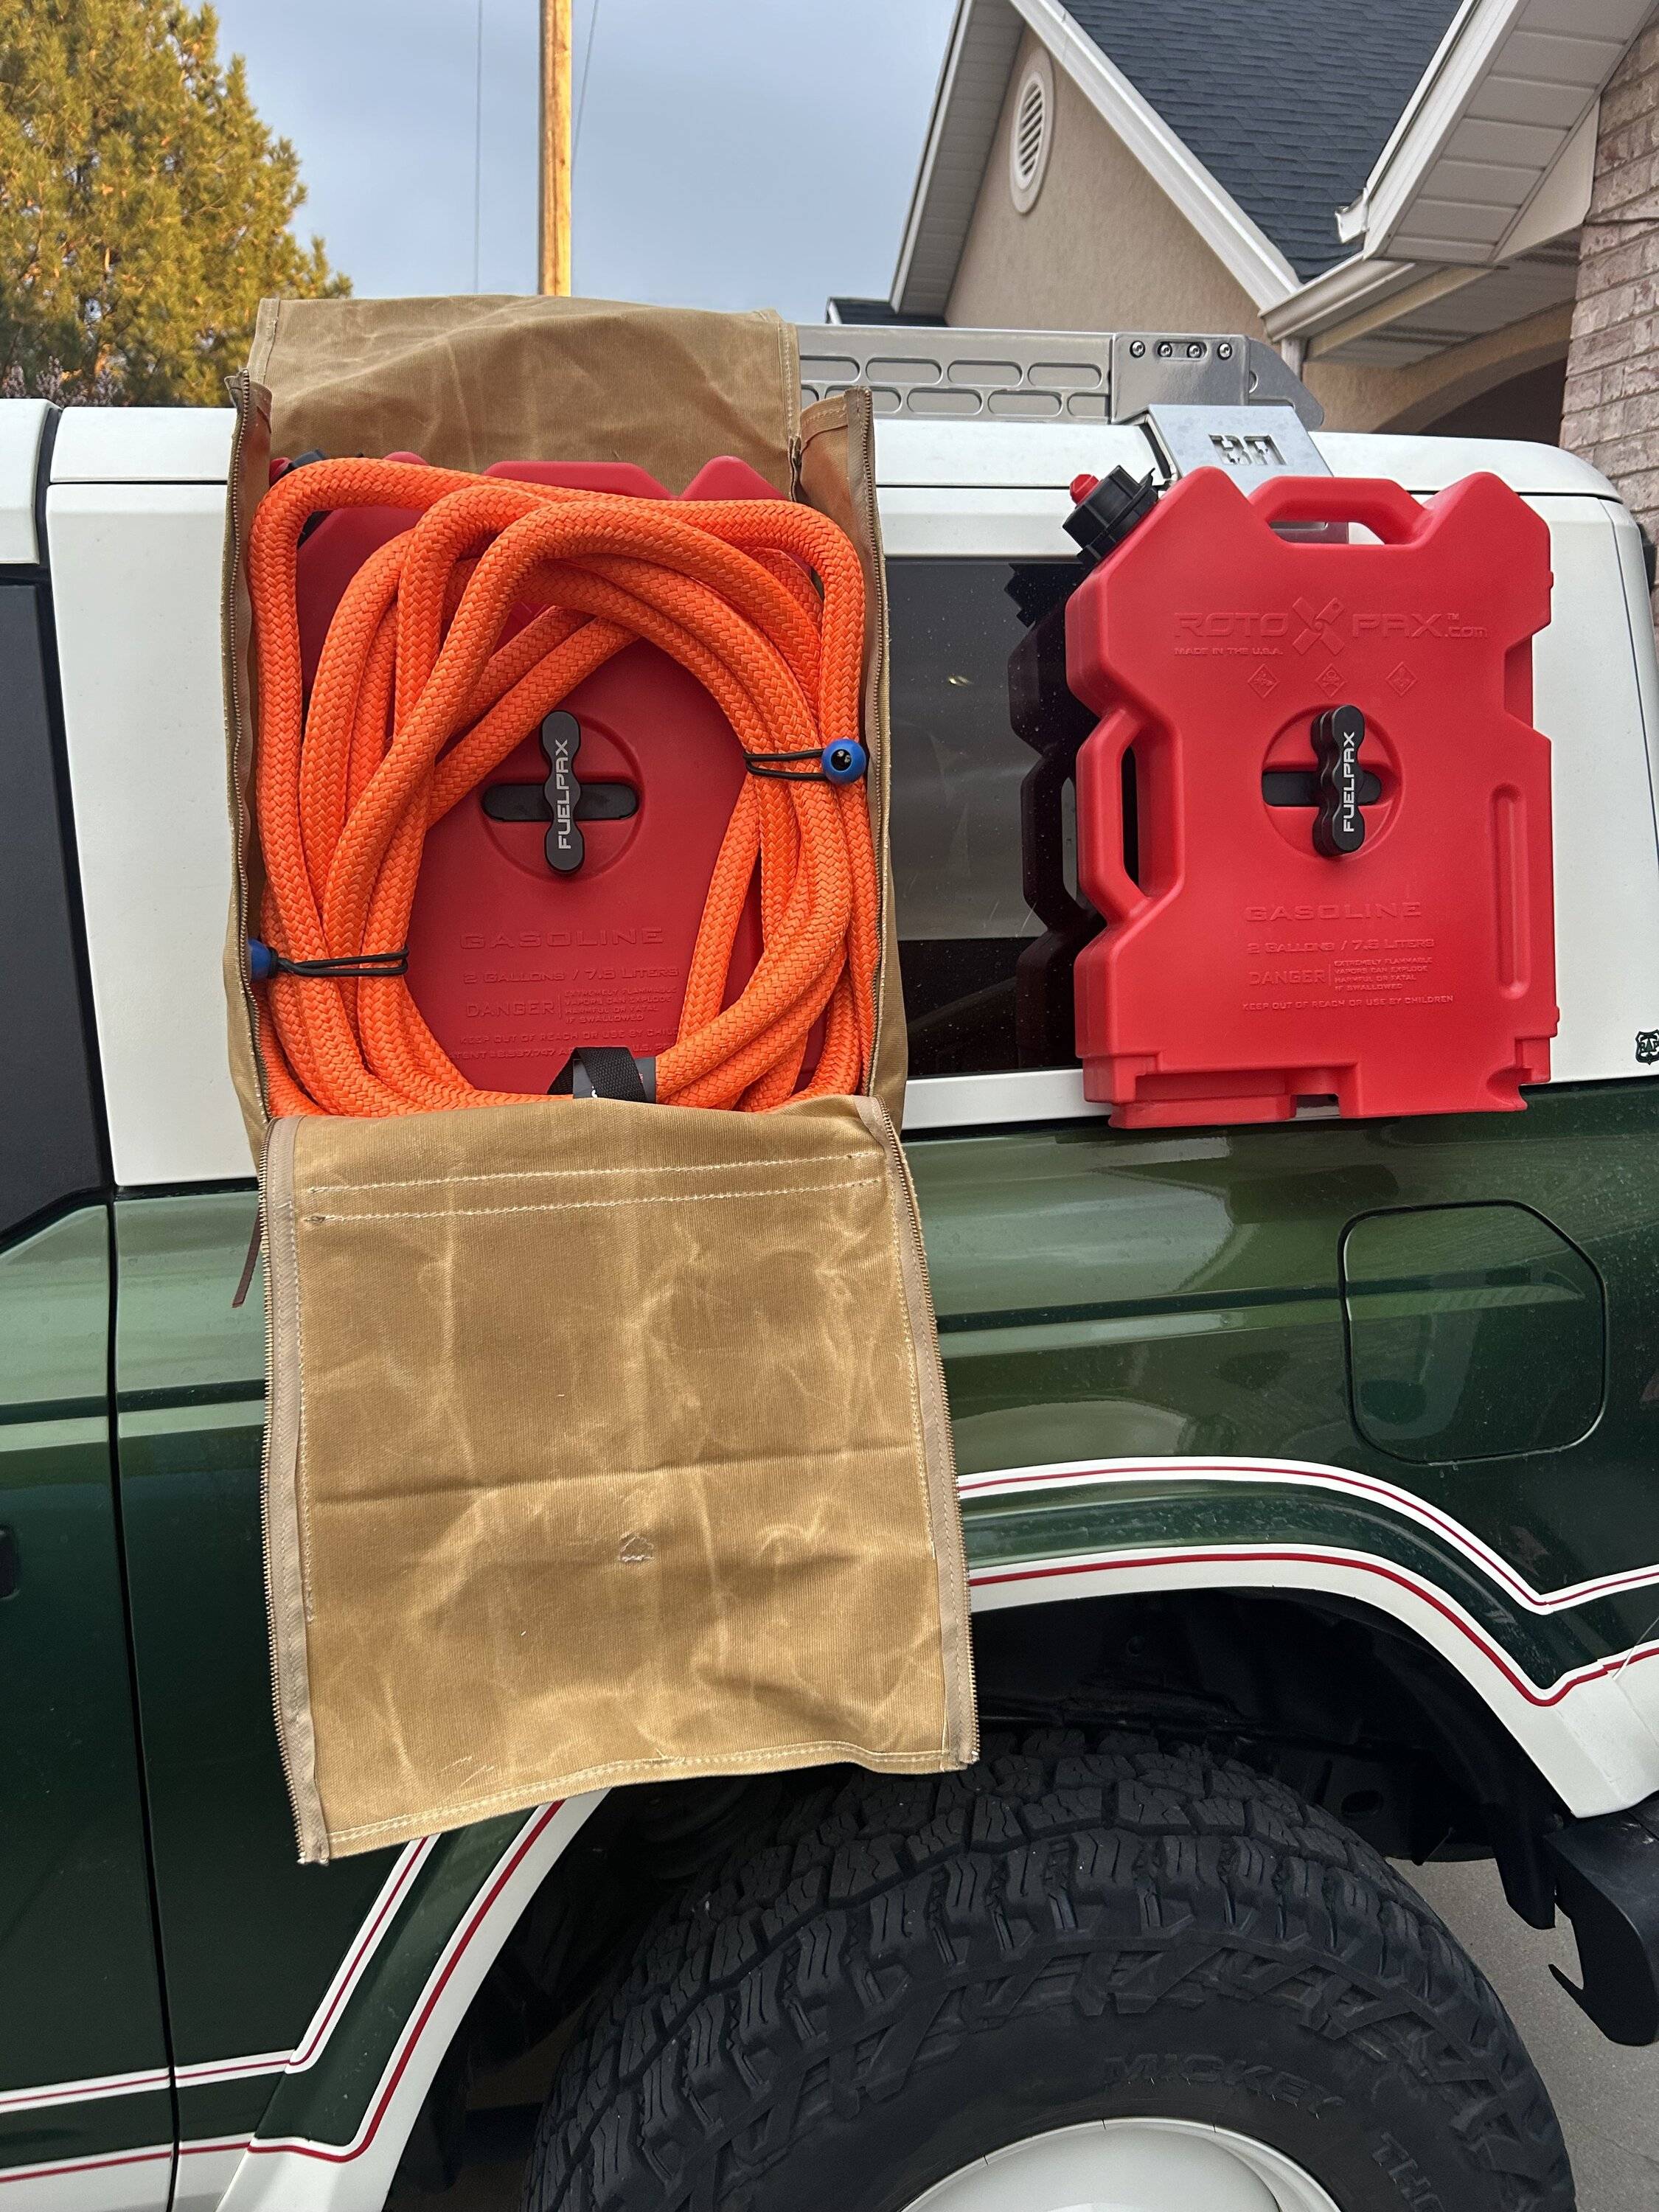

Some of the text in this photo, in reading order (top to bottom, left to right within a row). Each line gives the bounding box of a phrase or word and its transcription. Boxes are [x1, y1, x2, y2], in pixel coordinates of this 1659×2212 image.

[1174, 612, 1289, 638] ROTO
[1174, 647, 1208, 656] MADE
[1212, 647, 1223, 655] IN
[1227, 647, 1249, 655] THE
[1343, 731, 1355, 832] FUELPAX
[554, 738, 571, 849] FUELPAX
[1245, 901, 1422, 922] GASOLINE
[459, 926, 664, 949] GASOLINE
[1247, 942, 1260, 954] 2
[1265, 942, 1335, 953] GALLONS
[1383, 938, 1435, 949] LITERS
[1333, 958, 1381, 967] EXTREMELY
[1391, 965, 1428, 973] EXPLODE
[464, 973, 478, 984] 2
[484, 973, 566, 984] GALLONS
[585, 968, 616, 980] 7.5
[621, 967, 680, 979] LITERS
[1248, 969, 1326, 985] DANGER
[1346, 983, 1403, 992] SWALLOWED
[466, 1002, 555, 1018] DANGER
[1242, 995, 1454, 1011] KEEP OUT OF REACH OR USE BY CHILDREN
[579, 1015, 644, 1023] SWALLOWED
[460, 1035, 490, 1045] KEEP
[494, 1034, 517, 1043] OUT
[521, 1034, 535, 1043] OF
[540, 1032, 578, 1042] REACH
[583, 1032, 598, 1040] OR
[602, 1031, 625, 1039] USE
[629, 1029, 643, 1038] BY
